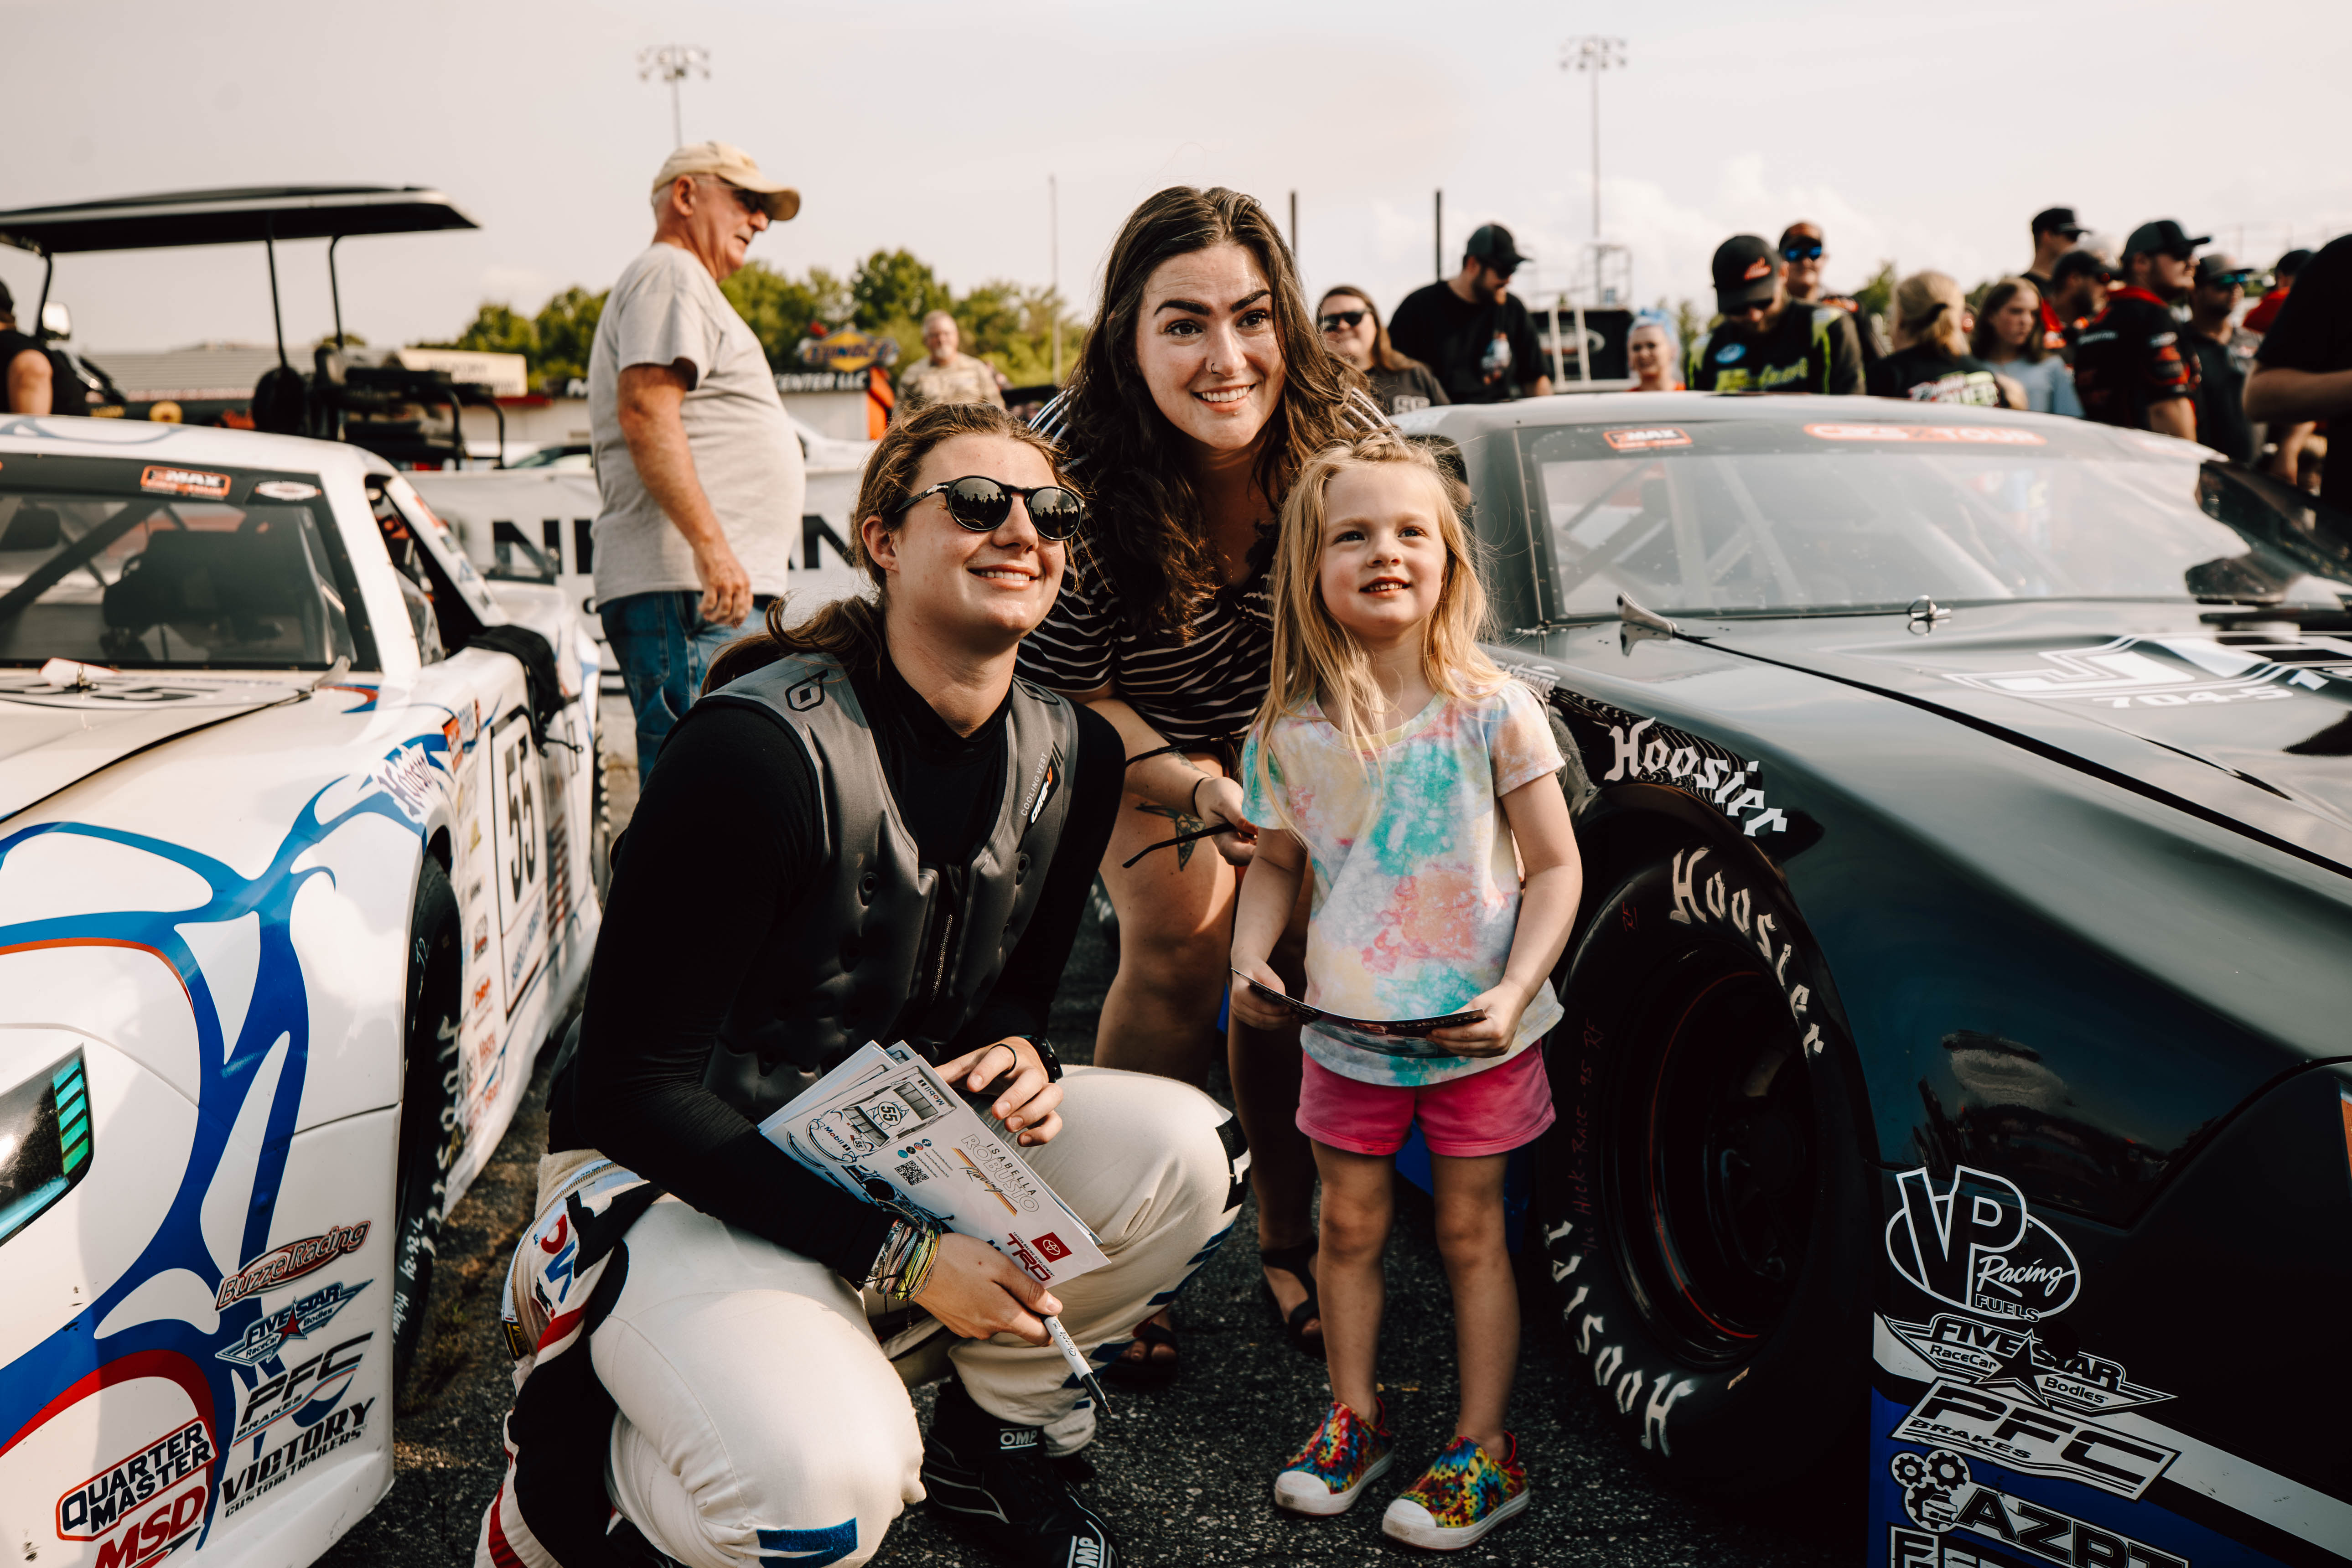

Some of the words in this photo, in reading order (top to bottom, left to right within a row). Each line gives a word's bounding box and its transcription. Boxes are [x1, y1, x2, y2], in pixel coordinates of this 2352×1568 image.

[1021, 776, 1040, 816] COOLING
[1036, 752, 1047, 774] VEST
[1604, 717, 1788, 837] Hoosier
[505, 733, 535, 903] 55
[1622, 901, 1636, 932] RF
[1669, 845, 1825, 1059] Hoosier
[1584, 1017, 1604, 1049] RF
[824, 1126, 844, 1145] Mobil
[881, 1105, 898, 1123] 55
[855, 1140, 863, 1149] 55
[987, 1144, 1036, 1195] ISABELLA
[959, 1167, 1019, 1204] Racing
[960, 1134, 1039, 1212] ROBUSTO
[1007, 1233, 1051, 1281] TRD
[1012, 1232, 1024, 1244] TOYOTA
[1023, 1244, 1035, 1256] RACING
[1034, 1255, 1056, 1278] DEVELOPMENT
[1896, 1164, 2028, 1307] VP
[215, 1255, 288, 1311] Buzze
[288, 1220, 371, 1273] Racing
[1975, 1254, 2078, 1297] Racing
[246, 1335, 279, 1358] RaceCar
[303, 1307, 335, 1327] Bodies
[247, 1309, 290, 1345] FIVE
[295, 1281, 343, 1317] STAR
[1974, 1294, 2040, 1323] FUELS
[1059, 1330, 1077, 1356] Sharpie
[1542, 1221, 1697, 1458] Hoosier
[1936, 1321, 2025, 1356] FIVE
[2032, 1342, 2123, 1391] SAR
[240, 1331, 374, 1427] PFC
[1929, 1345, 1997, 1371] RaceCar
[2045, 1377, 2109, 1405] Bodies
[236, 1394, 302, 1438] BRAKES
[1000, 1429, 1038, 1446] OMP
[1910, 1420, 2032, 1459] BRAKES
[1917, 1391, 2167, 1485] PFC
[222, 1397, 375, 1502] VICTORY
[290, 1428, 363, 1477] TRAILERS
[62, 1422, 204, 1531] QUARTER
[91, 1442, 212, 1534] MASTER
[93, 1491, 206, 1568] MSD
[1073, 1537, 1100, 1568] MP
